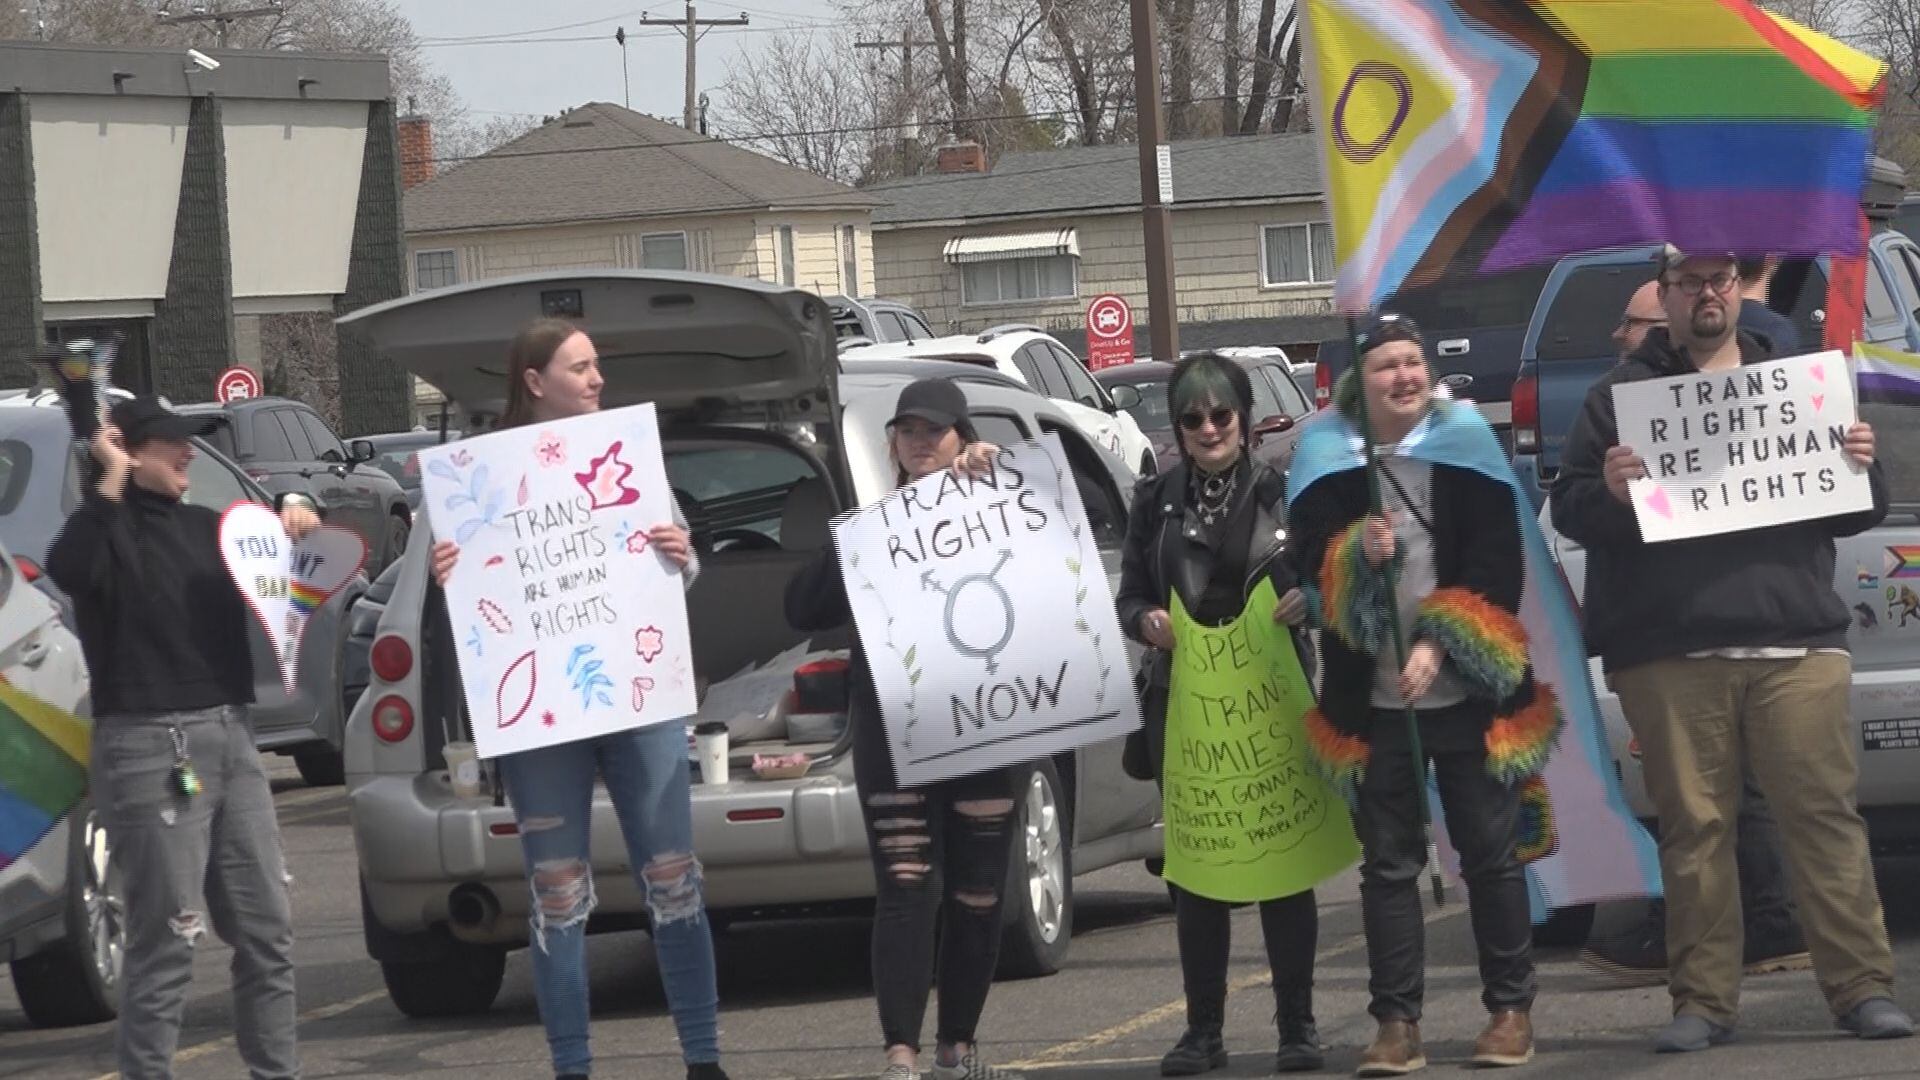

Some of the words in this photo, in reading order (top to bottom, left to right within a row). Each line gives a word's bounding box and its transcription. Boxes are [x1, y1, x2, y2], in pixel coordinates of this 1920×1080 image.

[1669, 367, 1788, 408] TRANS
[1650, 400, 1797, 443] RIGHTS
[1727, 424, 1846, 467] HUMAN
[872, 444, 1024, 528] TRANS
[1690, 467, 1836, 511] RIGHTS
[504, 495, 592, 539] TRANS
[887, 488, 1047, 569] RIGHTS
[235, 536, 278, 559] YOU
[514, 525, 607, 578] RIGHTS
[524, 582, 548, 603] ARE
[556, 564, 607, 593] HUMAN
[530, 592, 618, 641] RIGHTS
[950, 660, 1068, 737] NOW
[1180, 720, 1293, 775] HOMIES
[1172, 803, 1244, 829] IDENTIFY
[1258, 801, 1285, 823] AS
[1293, 787, 1308, 808] A
[1232, 766, 1299, 806] GONNA
